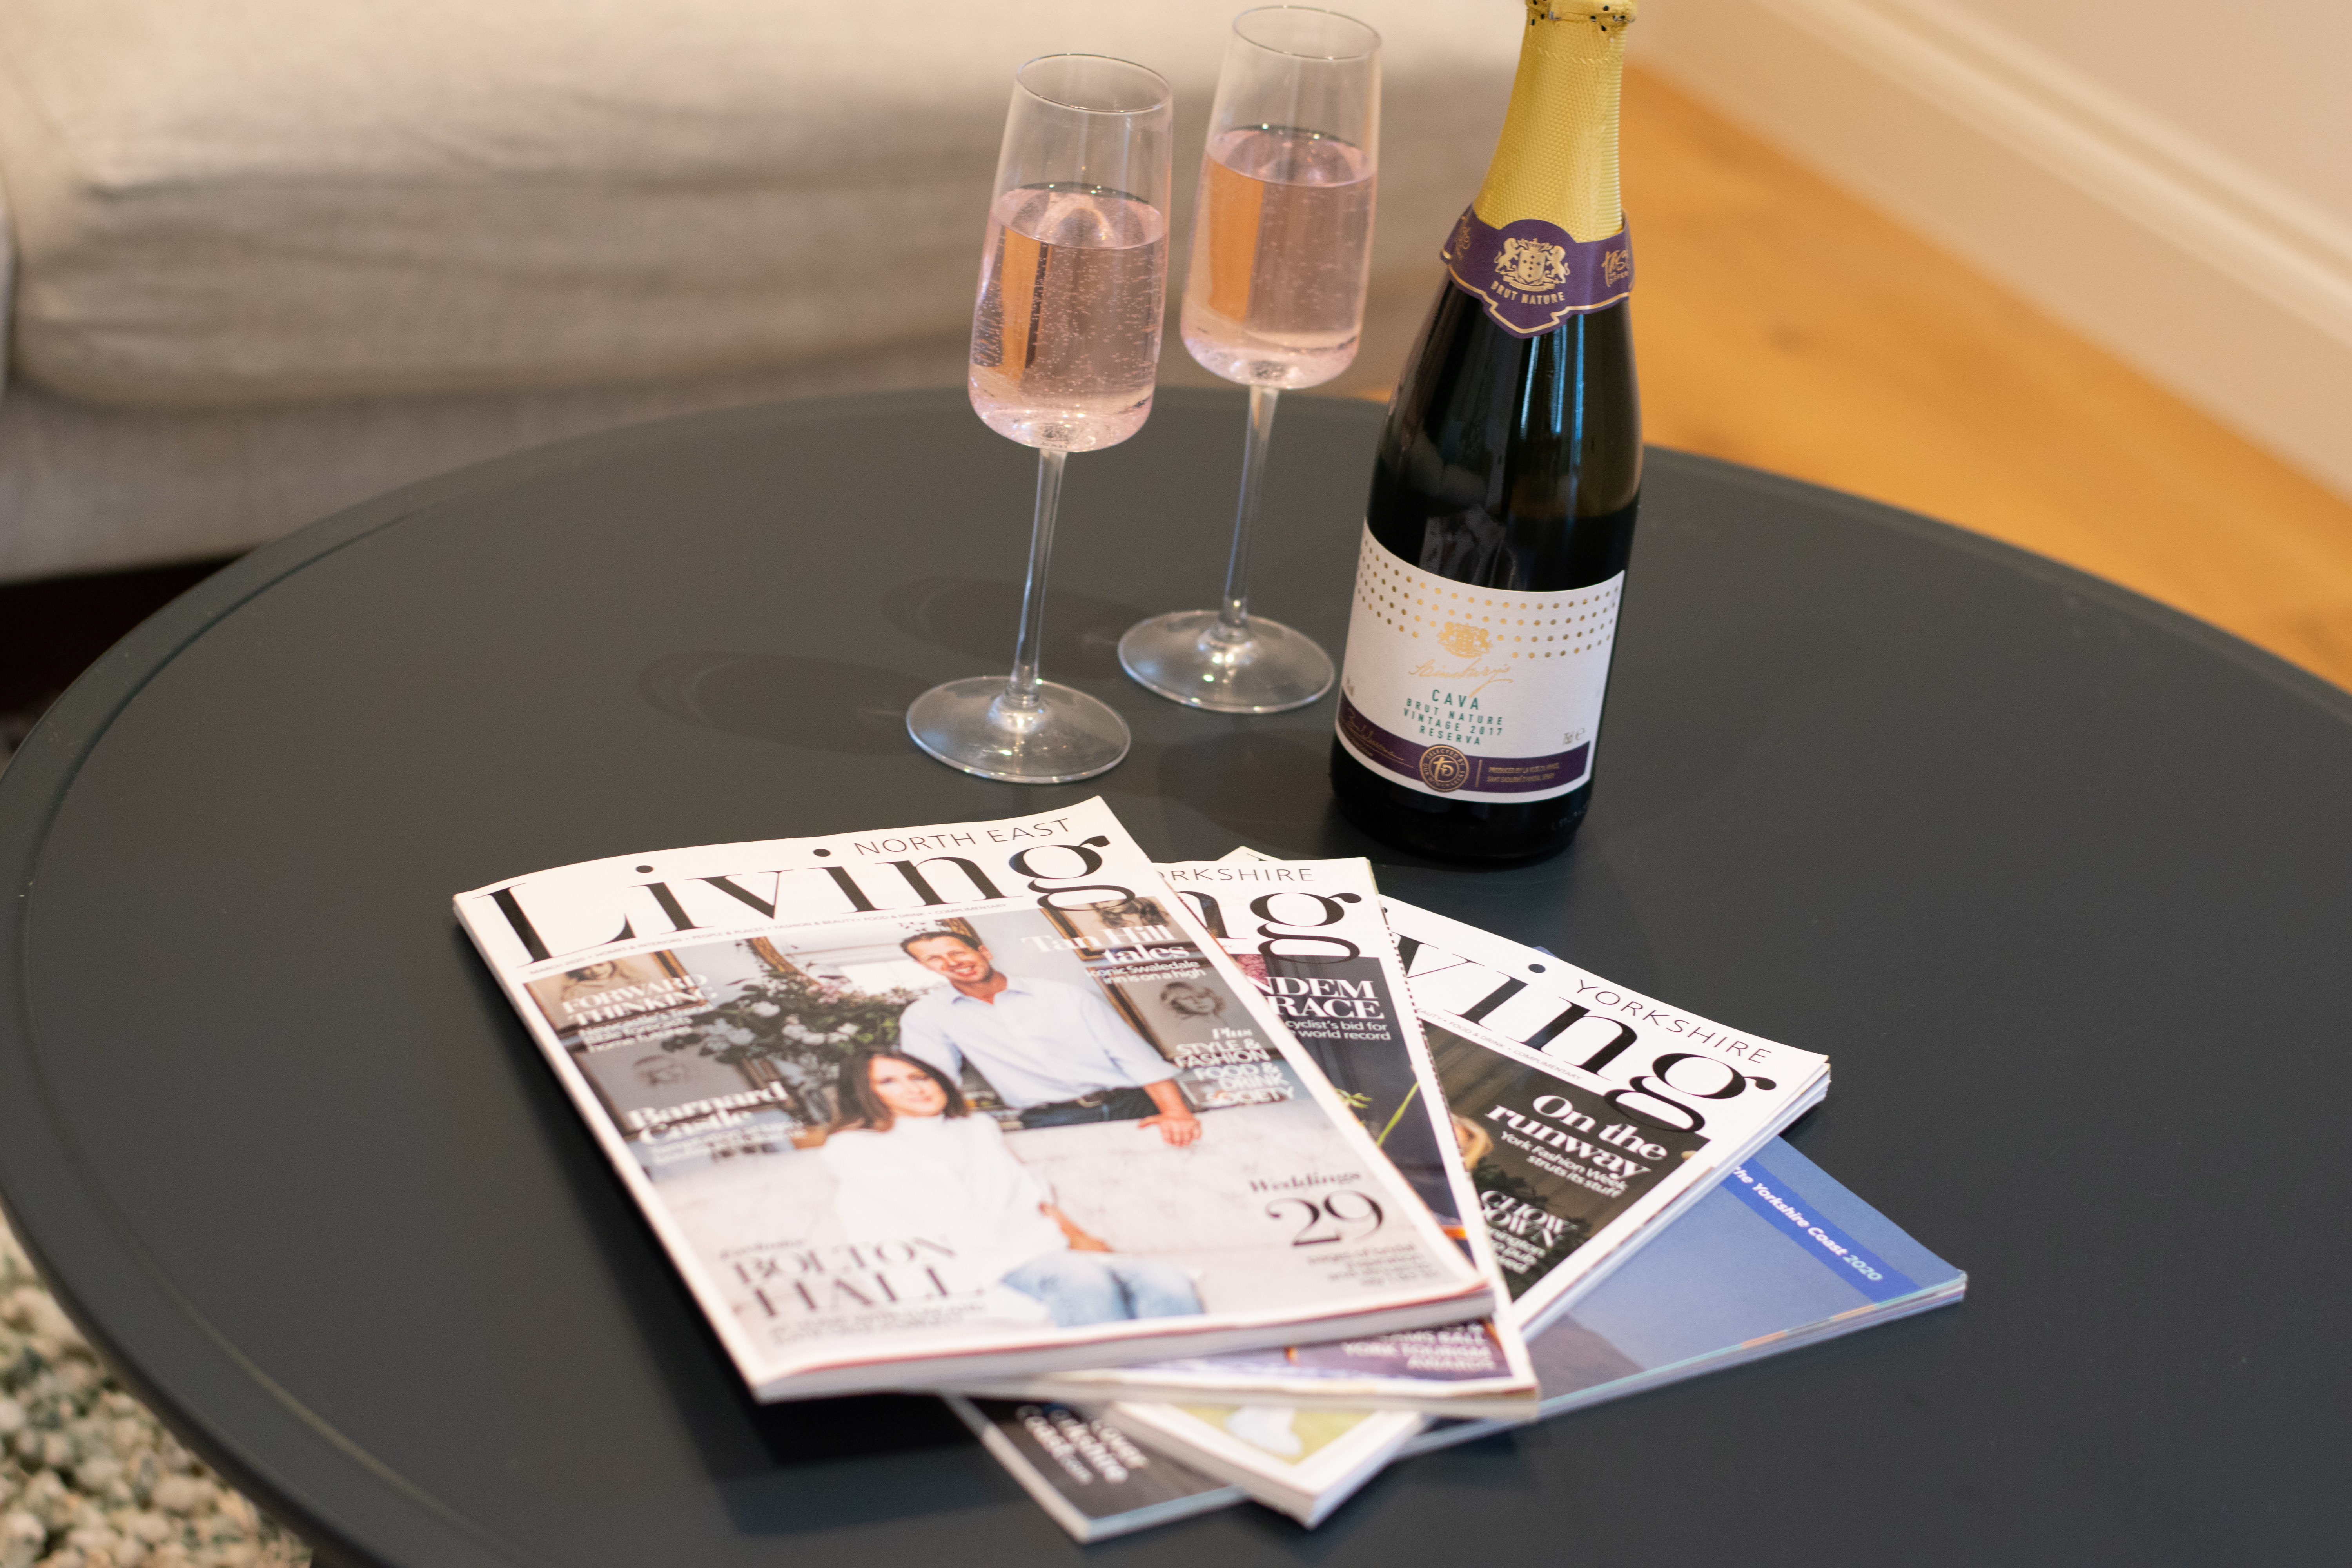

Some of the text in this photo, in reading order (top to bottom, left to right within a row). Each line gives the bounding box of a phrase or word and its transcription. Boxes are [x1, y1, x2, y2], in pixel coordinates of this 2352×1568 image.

[1490, 280, 1565, 305] BRUT NATURE
[1406, 698, 1503, 725] BRUT NATURE
[1432, 689, 1479, 710] CAVA
[1404, 708, 1503, 736] VINTAGE 2017
[1419, 725, 1480, 745] RESERVA
[854, 818, 1073, 855] NORTH EAST
[472, 835, 1136, 967] Living
[594, 947, 628, 957] HOMES
[636, 938, 683, 948] INTERIORS
[692, 931, 724, 940] PEOPLE
[733, 926, 765, 935] PLACES
[774, 920, 812, 929] FASHION
[935, 903, 1007, 915] COMPLIMENTARY
[1022, 924, 1177, 952] Tan Hill
[1103, 944, 1190, 964] tales
[1126, 960, 1200, 974] Swaledale
[1140, 973, 1161, 982] on
[1170, 967, 1206, 980] high
[1247, 976, 1378, 999] NDEM
[563, 975, 708, 1013] FORWARD
[568, 986, 717, 1026] THINKING
[1212, 1027, 1253, 1040] Plus
[1285, 1019, 1388, 1031] cyclist's bid for
[1298, 1029, 1341, 1039] world
[1344, 1031, 1392, 1041] record
[1392, 931, 1777, 1132] ving
[1575, 979, 1773, 1063] YORKSHIRE
[1174, 1049, 1271, 1068] FASHION
[1176, 1038, 1263, 1055] STYLE &
[1415, 1007, 1443, 1020] EAUTY
[1448, 1021, 1472, 1033] FOOD
[1479, 1035, 1506, 1048] DRINK
[1513, 1050, 1583, 1080] COMPLIMENTARY
[1194, 1062, 1280, 1081] FOOD &
[1218, 1074, 1290, 1091] DRINK
[628, 1080, 788, 1129] Barnard
[1205, 1085, 1294, 1103] SOCIETY
[639, 1109, 752, 1145] Castle
[1484, 1104, 1652, 1180] runway
[1532, 1095, 1668, 1160] On the
[1501, 1131, 1629, 1191] York Fashion Week
[1526, 1155, 1624, 1198] struts its stuff
[1249, 1171, 1361, 1192] Weddings
[1265, 1189, 1384, 1246] 29
[1480, 1190, 1579, 1234] CHOW
[1752, 1182, 1810, 1227] Yorkshire
[1807, 1227, 1848, 1256] Coast
[1843, 1254, 1883, 1281] 2020
[734, 1238, 958, 1285] BOLTON
[1049, 1409, 1129, 1483] orkshire
